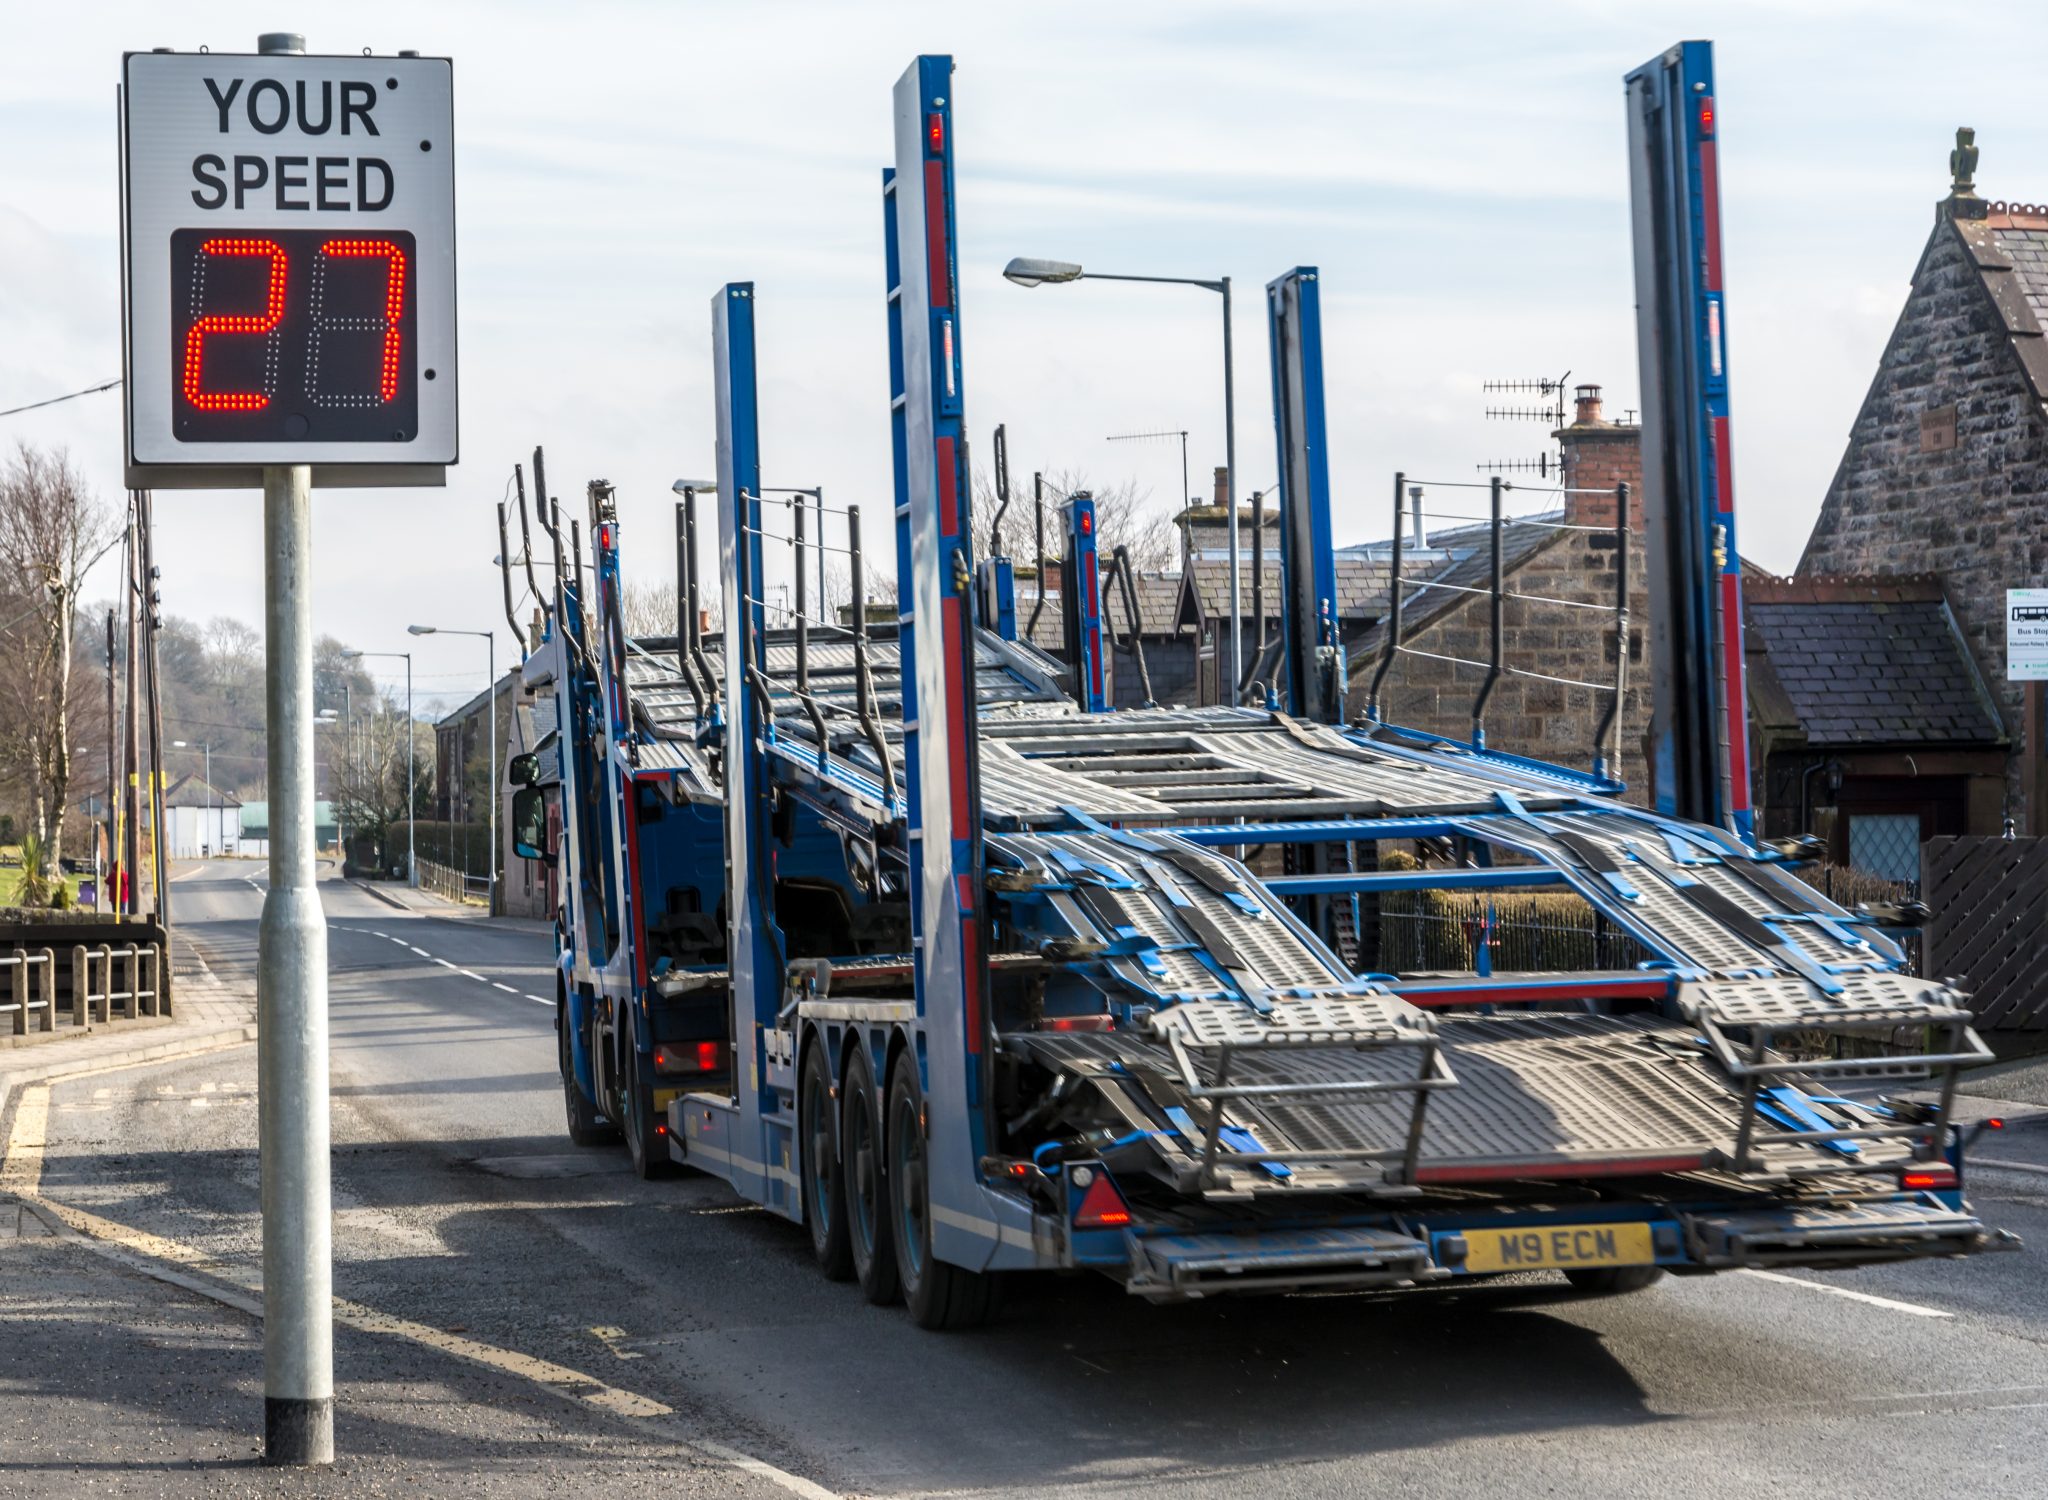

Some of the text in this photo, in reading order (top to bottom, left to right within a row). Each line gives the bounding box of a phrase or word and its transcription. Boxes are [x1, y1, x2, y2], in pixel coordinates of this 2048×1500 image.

[203, 77, 380, 136] YOUR
[190, 153, 395, 212] SPEED
[183, 238, 406, 410] 27
[2017, 627, 2031, 635] Bus
[1498, 1228, 1619, 1265] M9 ECM
